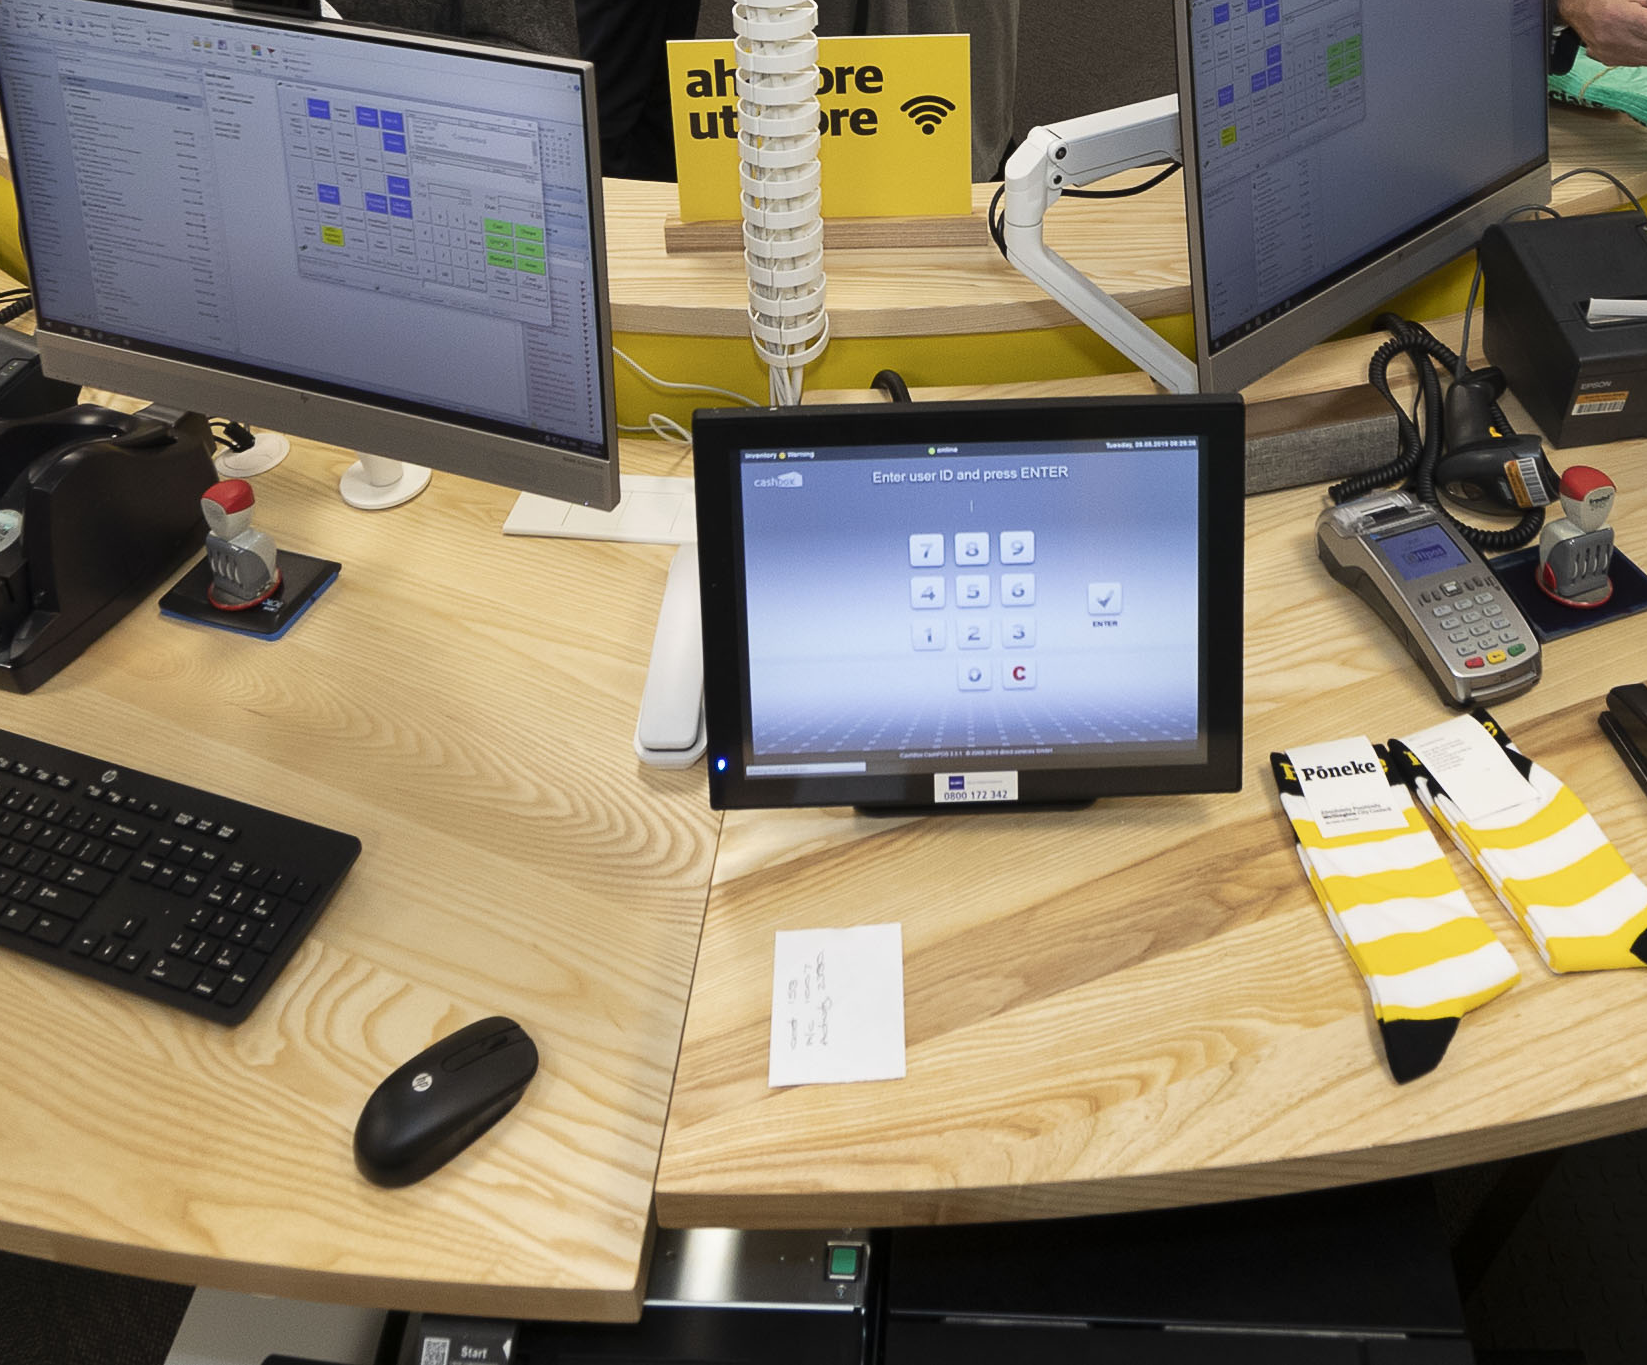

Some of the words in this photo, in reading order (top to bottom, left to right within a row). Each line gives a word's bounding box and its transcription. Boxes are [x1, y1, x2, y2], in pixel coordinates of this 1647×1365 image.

[686, 59, 884, 97] ahore
[1580, 381, 1613, 390] EPSON
[872, 471, 906, 483] Enter
[909, 472, 936, 482] user
[940, 470, 953, 480] ID
[957, 469, 980, 480] and
[983, 468, 1017, 482] press
[1021, 466, 1068, 479] ENTER
[1012, 666, 1026, 681] C
[1301, 760, 1377, 782] Pōneke
[944, 791, 967, 800] 0800
[971, 791, 987, 799] 172
[991, 790, 1008, 799] 342
[461, 1345, 488, 1359] Start
